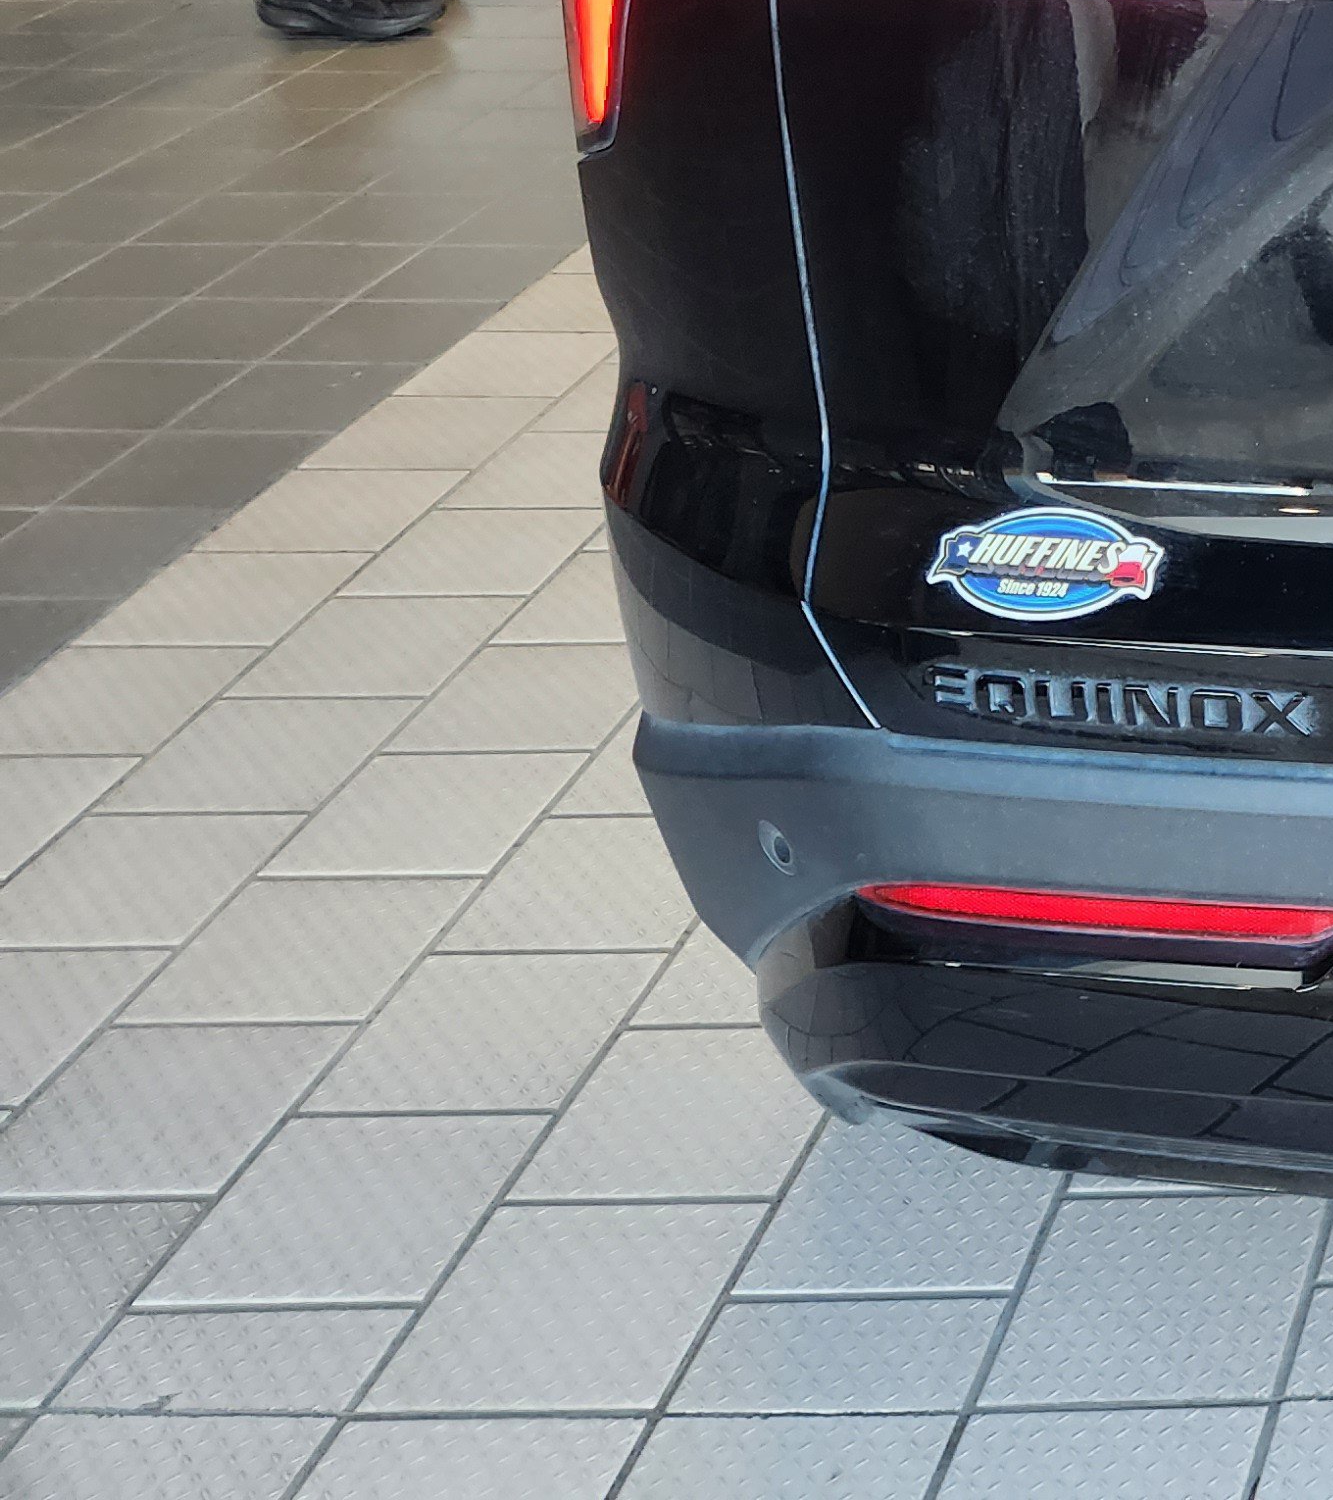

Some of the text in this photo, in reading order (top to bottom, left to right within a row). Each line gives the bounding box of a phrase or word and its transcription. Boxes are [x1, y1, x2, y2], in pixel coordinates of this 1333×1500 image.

[969, 534, 1126, 574] HUFFINES
[998, 578, 1069, 598] Since 1924
[927, 665, 1314, 737] EQUINOX
